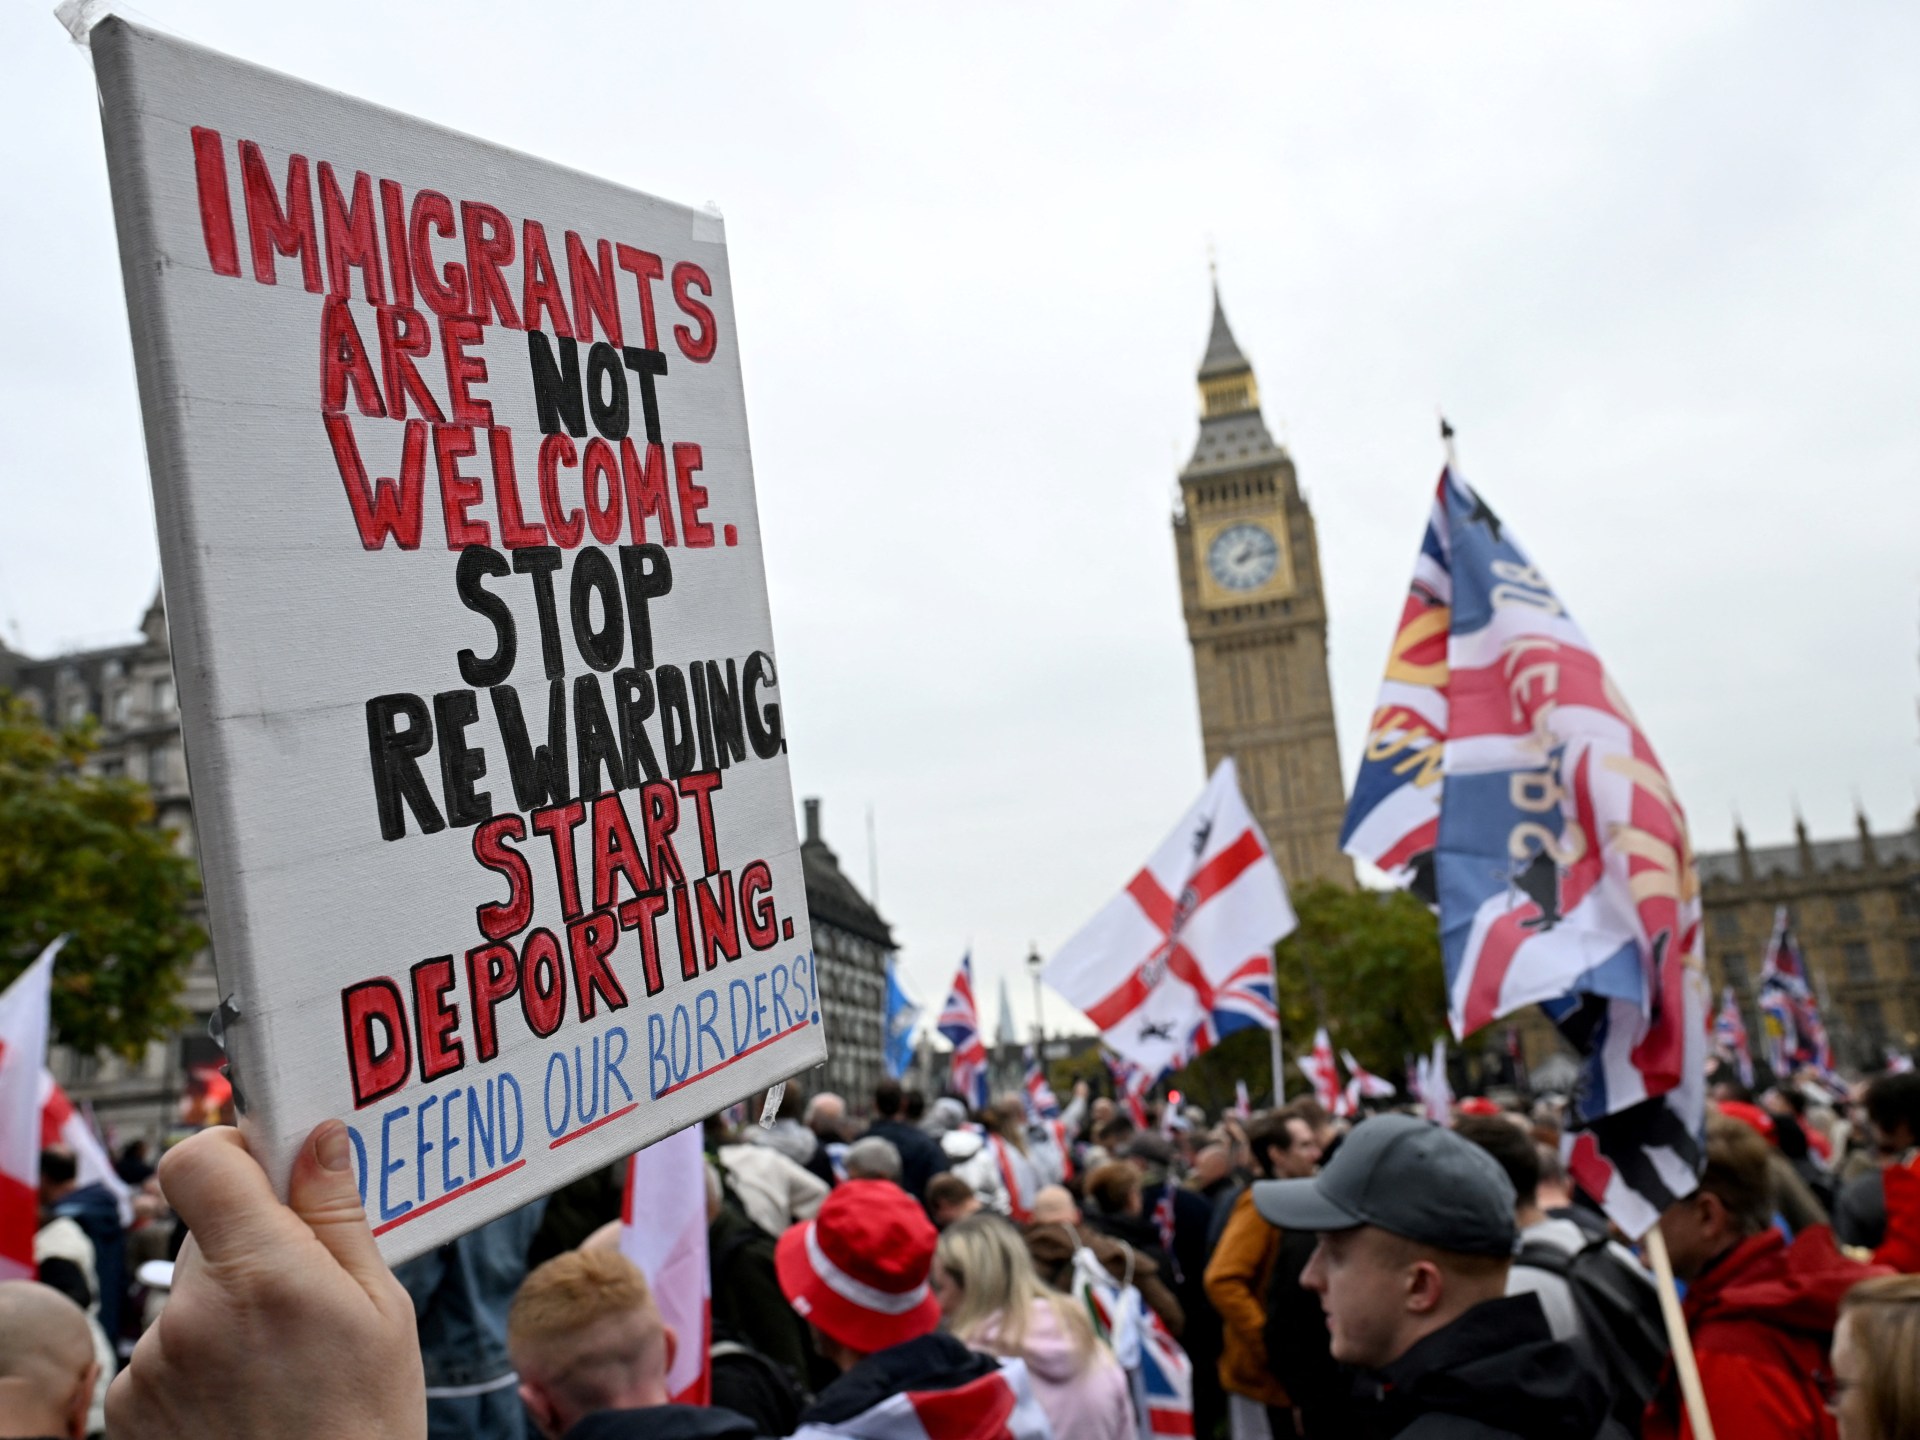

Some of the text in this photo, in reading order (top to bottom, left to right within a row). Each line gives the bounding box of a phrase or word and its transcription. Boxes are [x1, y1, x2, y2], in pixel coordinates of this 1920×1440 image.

[191, 125, 717, 363] IMMIGRANTS
[320, 294, 667, 445] ARE NOT
[322, 411, 738, 551] WELCOME.
[456, 543, 673, 688] STOP
[472, 767, 723, 941] START
[341, 858, 795, 1111] DEPORTING.
[544, 1026, 634, 1139] OUR
[648, 950, 820, 1100] BORDERS!
